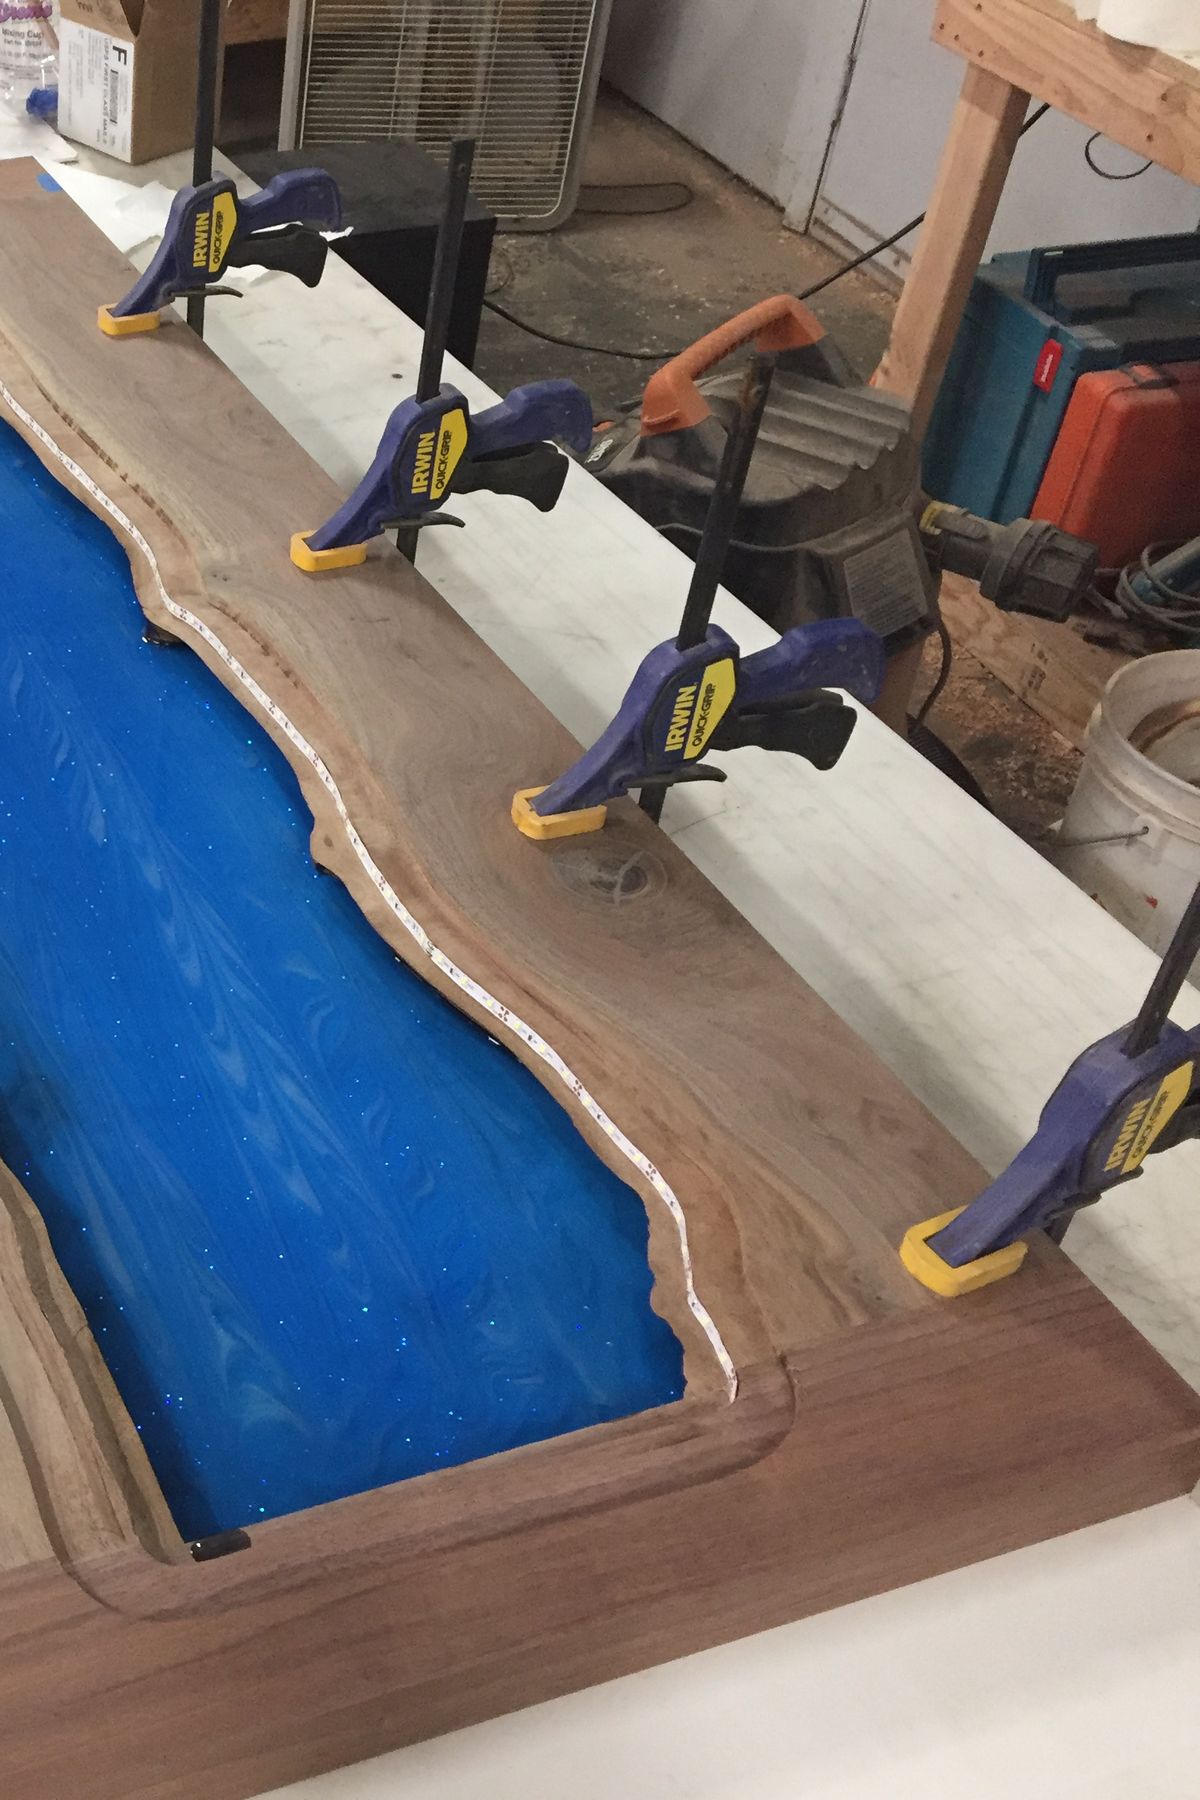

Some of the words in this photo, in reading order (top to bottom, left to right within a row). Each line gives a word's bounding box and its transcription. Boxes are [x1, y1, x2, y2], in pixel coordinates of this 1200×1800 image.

[27, 30, 44, 40] Cup
[112, 45, 127, 66] F
[193, 211, 210, 268] IRWIN
[411, 431, 436, 494] IRWIN
[664, 685, 697, 752] IRWIN
[1103, 1098, 1151, 1172] IRWIN
